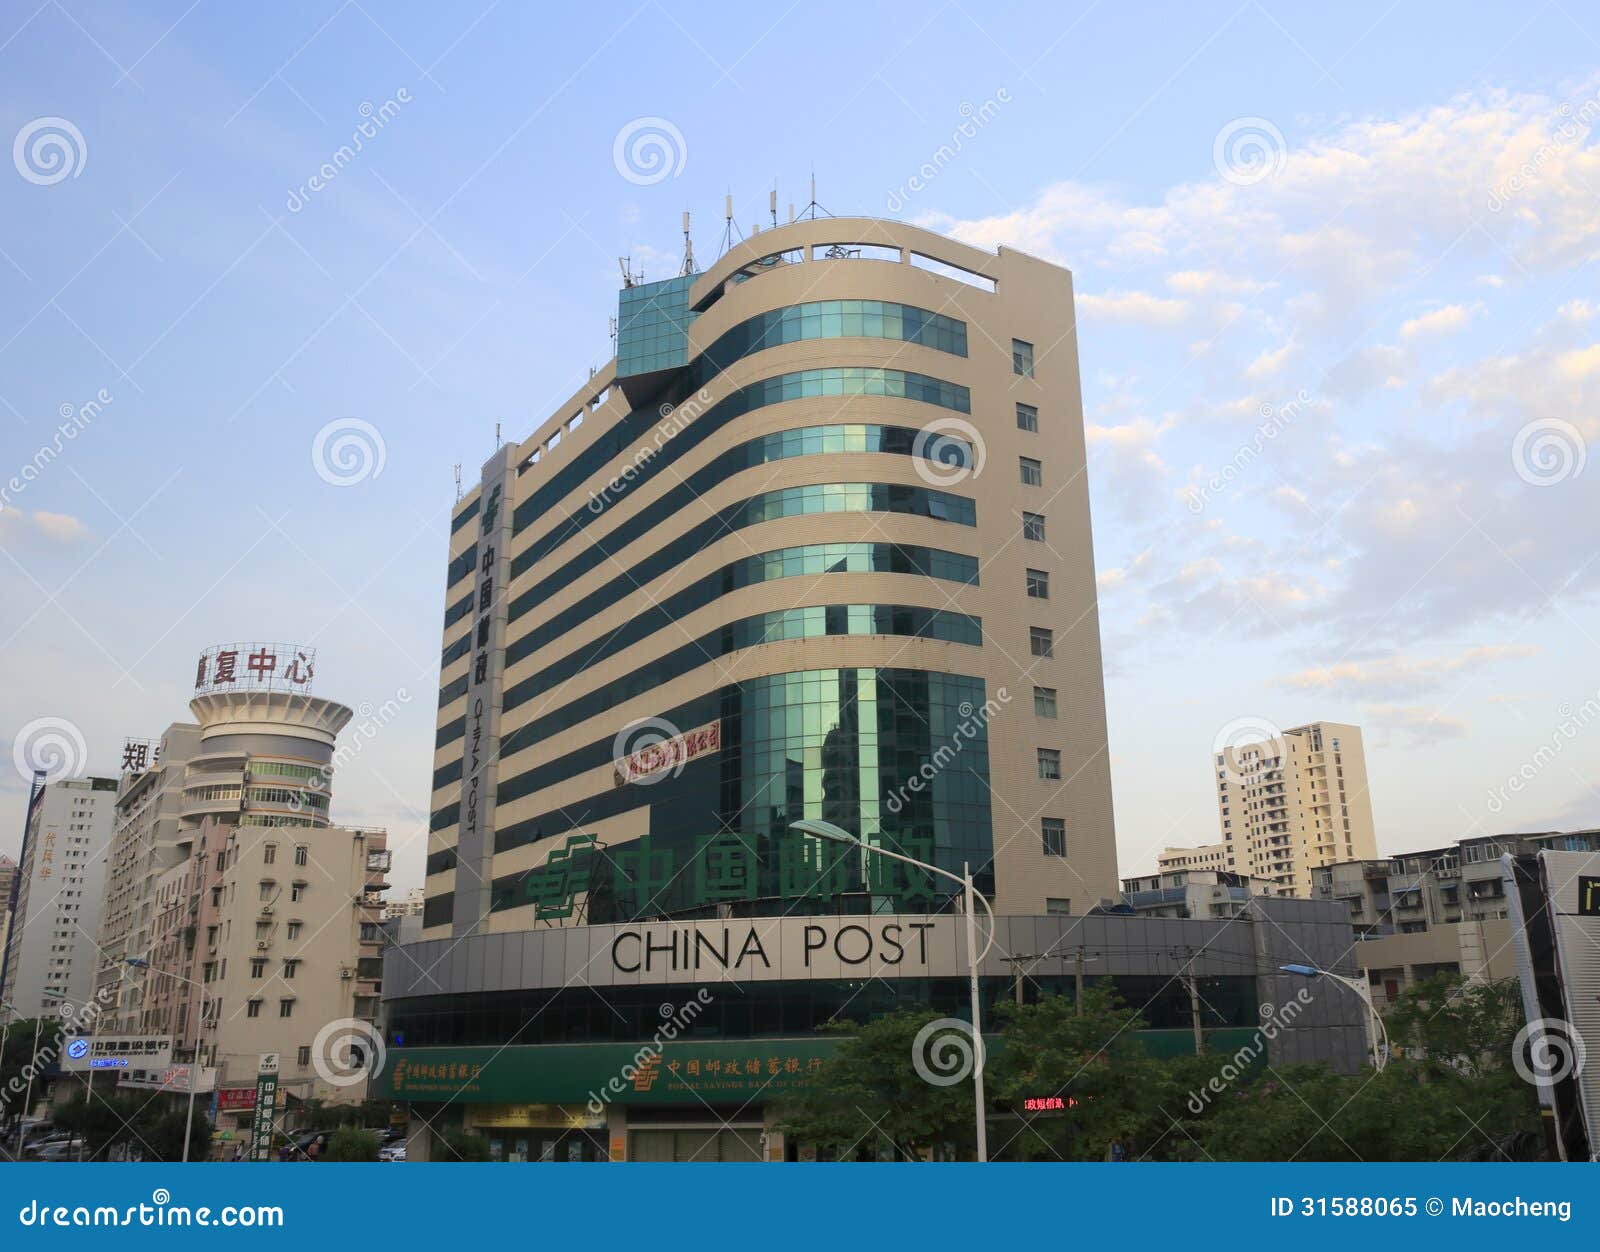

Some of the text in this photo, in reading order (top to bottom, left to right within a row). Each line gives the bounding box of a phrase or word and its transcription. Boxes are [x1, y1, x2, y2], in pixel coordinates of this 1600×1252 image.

[471, 698, 483, 772] CHINA
[467, 776, 479, 835] POST
[611, 922, 935, 973] CHINA POST
[667, 1056, 822, 1079] 中国邮政储蓄银行
